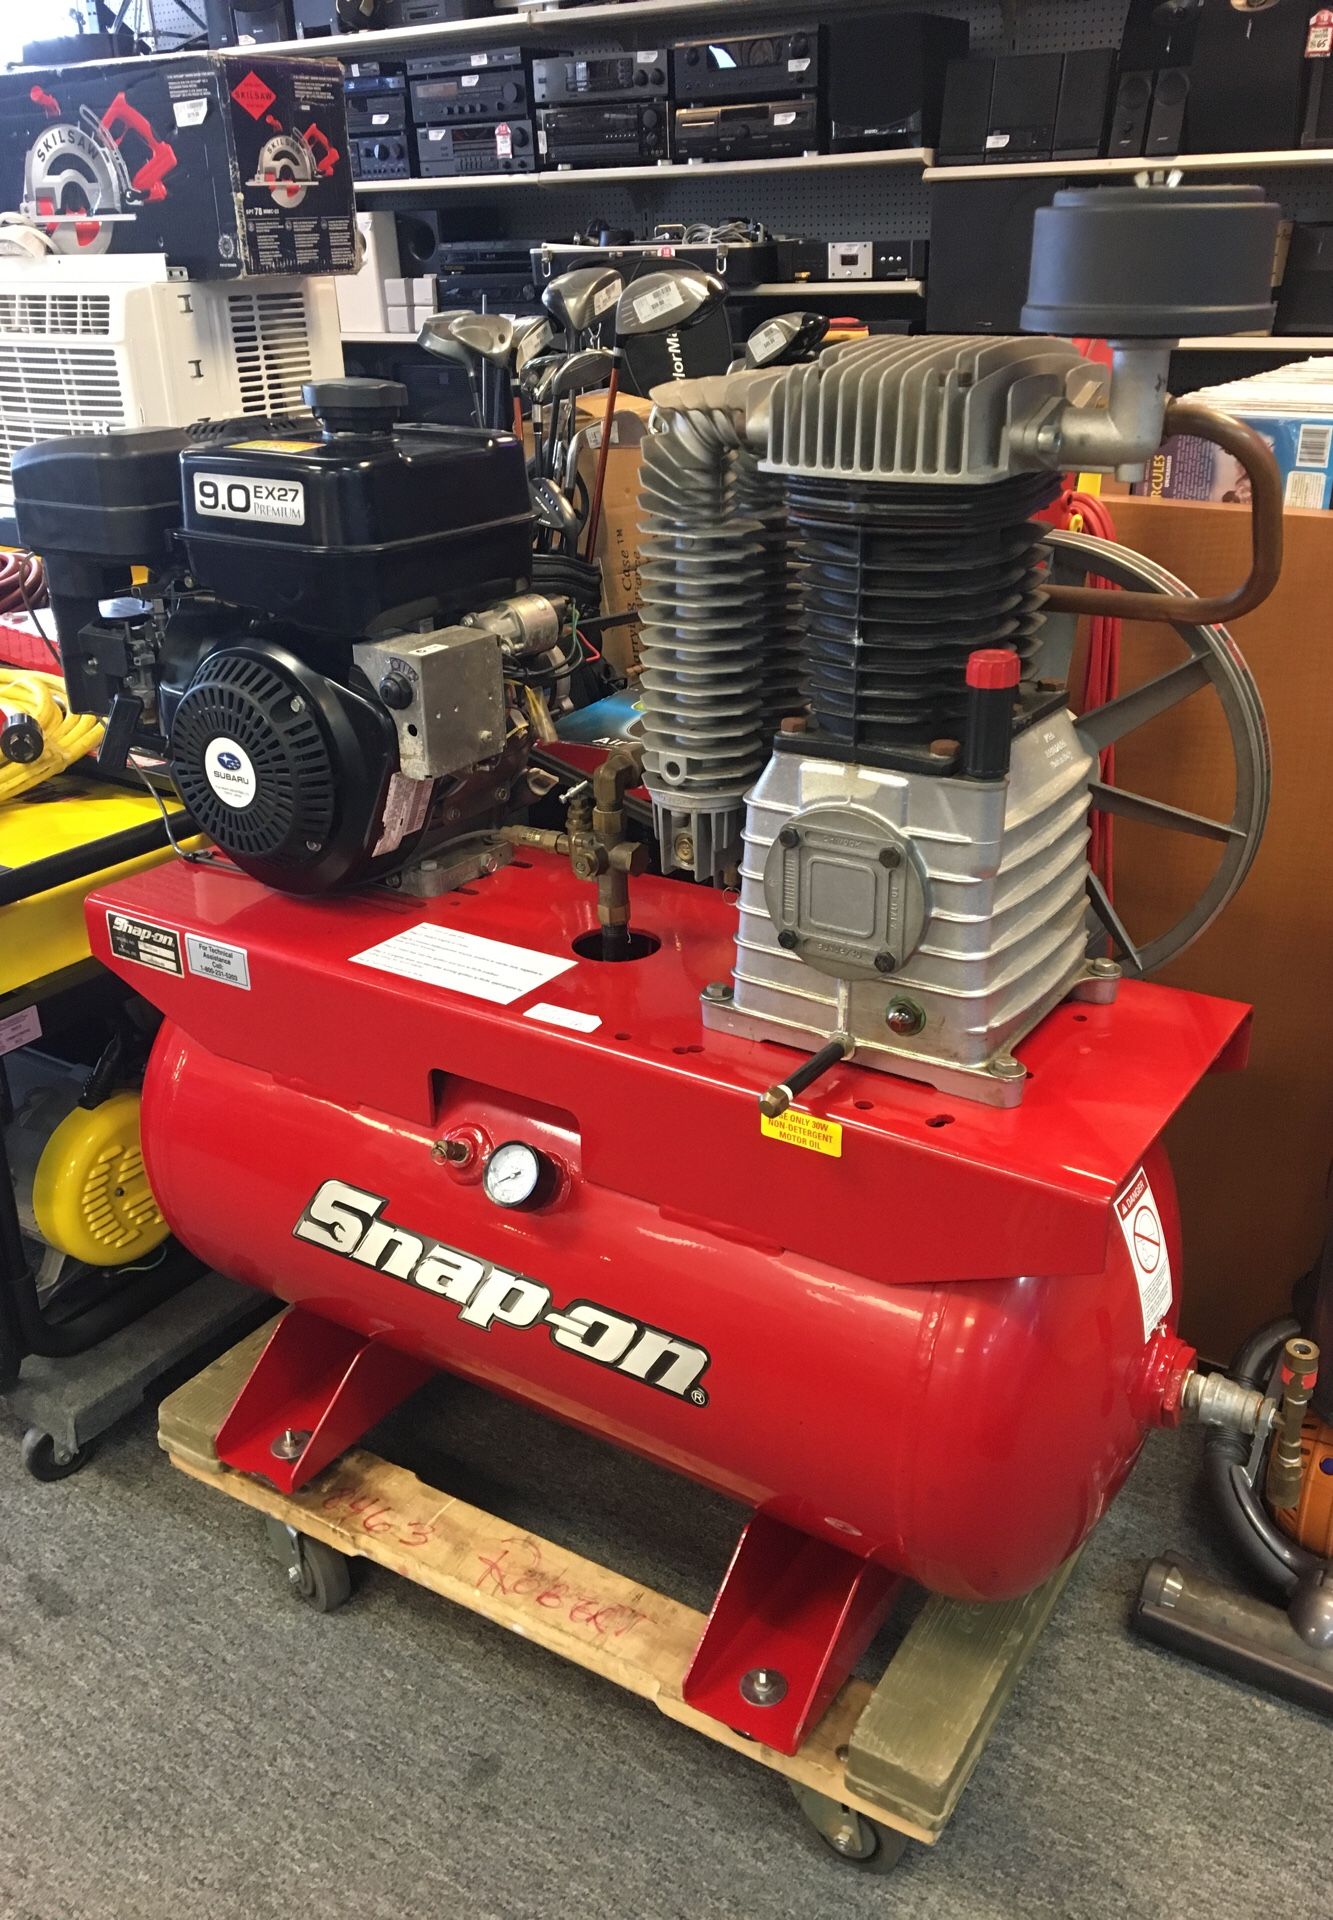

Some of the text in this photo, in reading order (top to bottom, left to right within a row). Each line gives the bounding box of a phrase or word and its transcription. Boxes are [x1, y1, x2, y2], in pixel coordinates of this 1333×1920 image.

[235, 91, 272, 100] SKILSAW
[37, 129, 99, 163] SKILSAW
[199, 480, 300, 513] 9.0 EX27
[253, 502, 301, 519] PREMIUM
[213, 770, 249, 785] SUBARU
[112, 916, 173, 946] Snap-on
[198, 943, 233, 959] For Technical
[789, 1114, 811, 1127] ONLY
[811, 1120, 829, 1132] 30W
[779, 1131, 822, 1150] MOTOR OIL
[1126, 1182, 1145, 1210] DANGER
